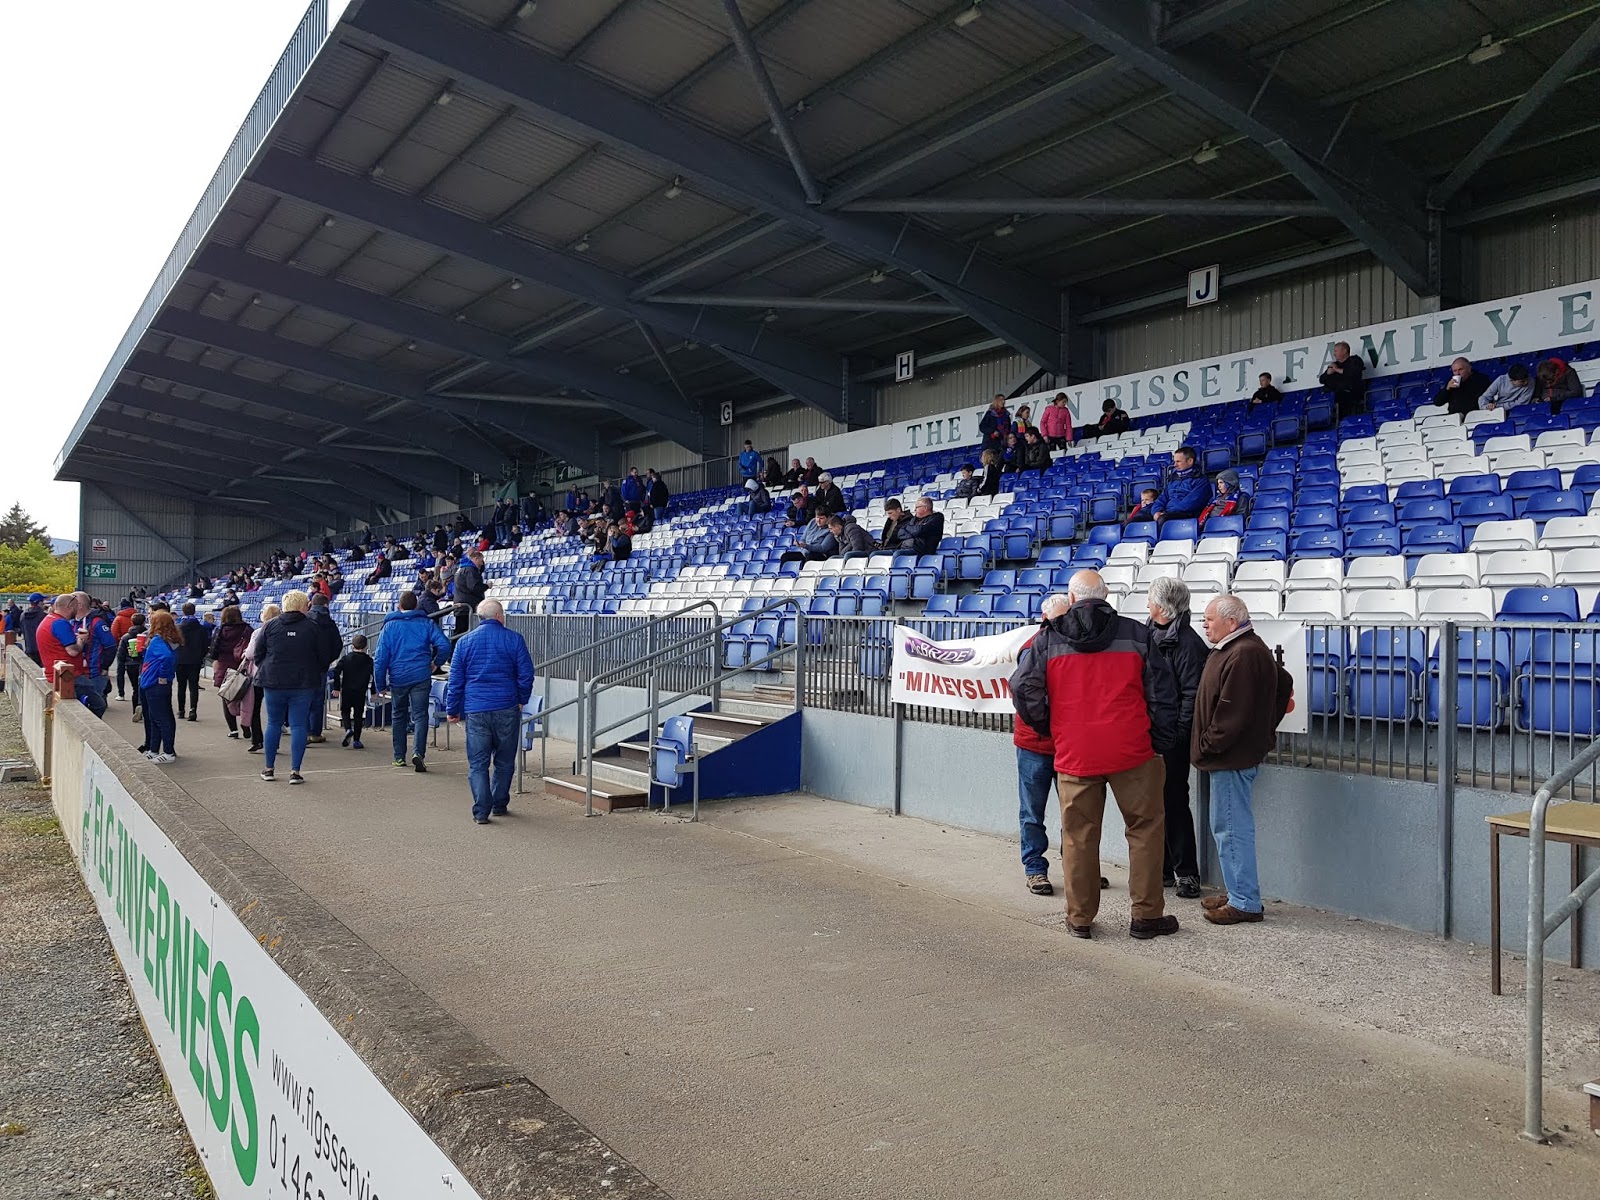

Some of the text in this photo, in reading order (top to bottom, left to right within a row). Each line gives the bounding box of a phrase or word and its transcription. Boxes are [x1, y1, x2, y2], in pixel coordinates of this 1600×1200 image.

[1196, 271, 1211, 299] J
[900, 355, 910, 377] H
[906, 416, 962, 449] THE
[1103, 357, 1254, 411] BISSET
[1558, 291, 1595, 337] E
[723, 405, 731, 421] G
[100, 567, 115, 575] EXIT
[94, 785, 260, 1187] FLG INVERNESS
[272, 1048, 380, 1200] www.flgsservi
[269, 1113, 326, 1200] 0146
